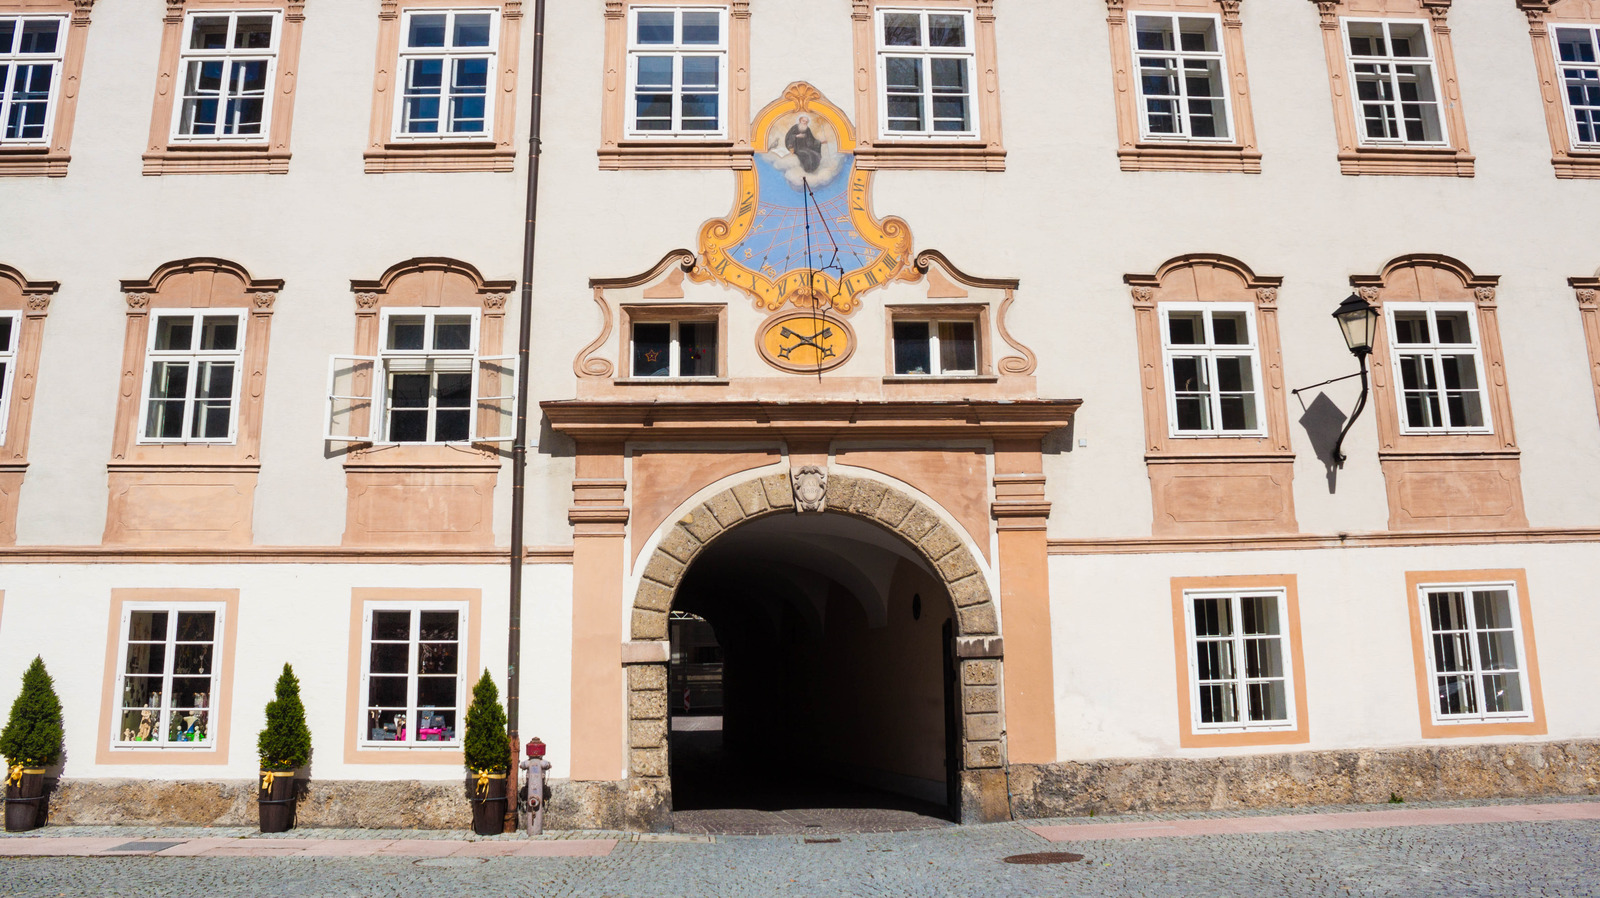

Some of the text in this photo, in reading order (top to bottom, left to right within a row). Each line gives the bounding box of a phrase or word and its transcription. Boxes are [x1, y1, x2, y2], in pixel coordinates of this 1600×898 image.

[852, 200, 864, 211] V
[715, 258, 731, 275] IX
[882, 253, 898, 271] IIII
[749, 275, 760, 290] X
[864, 270, 879, 286] III
[776, 279, 787, 302] XI
[844, 279, 855, 296] II
